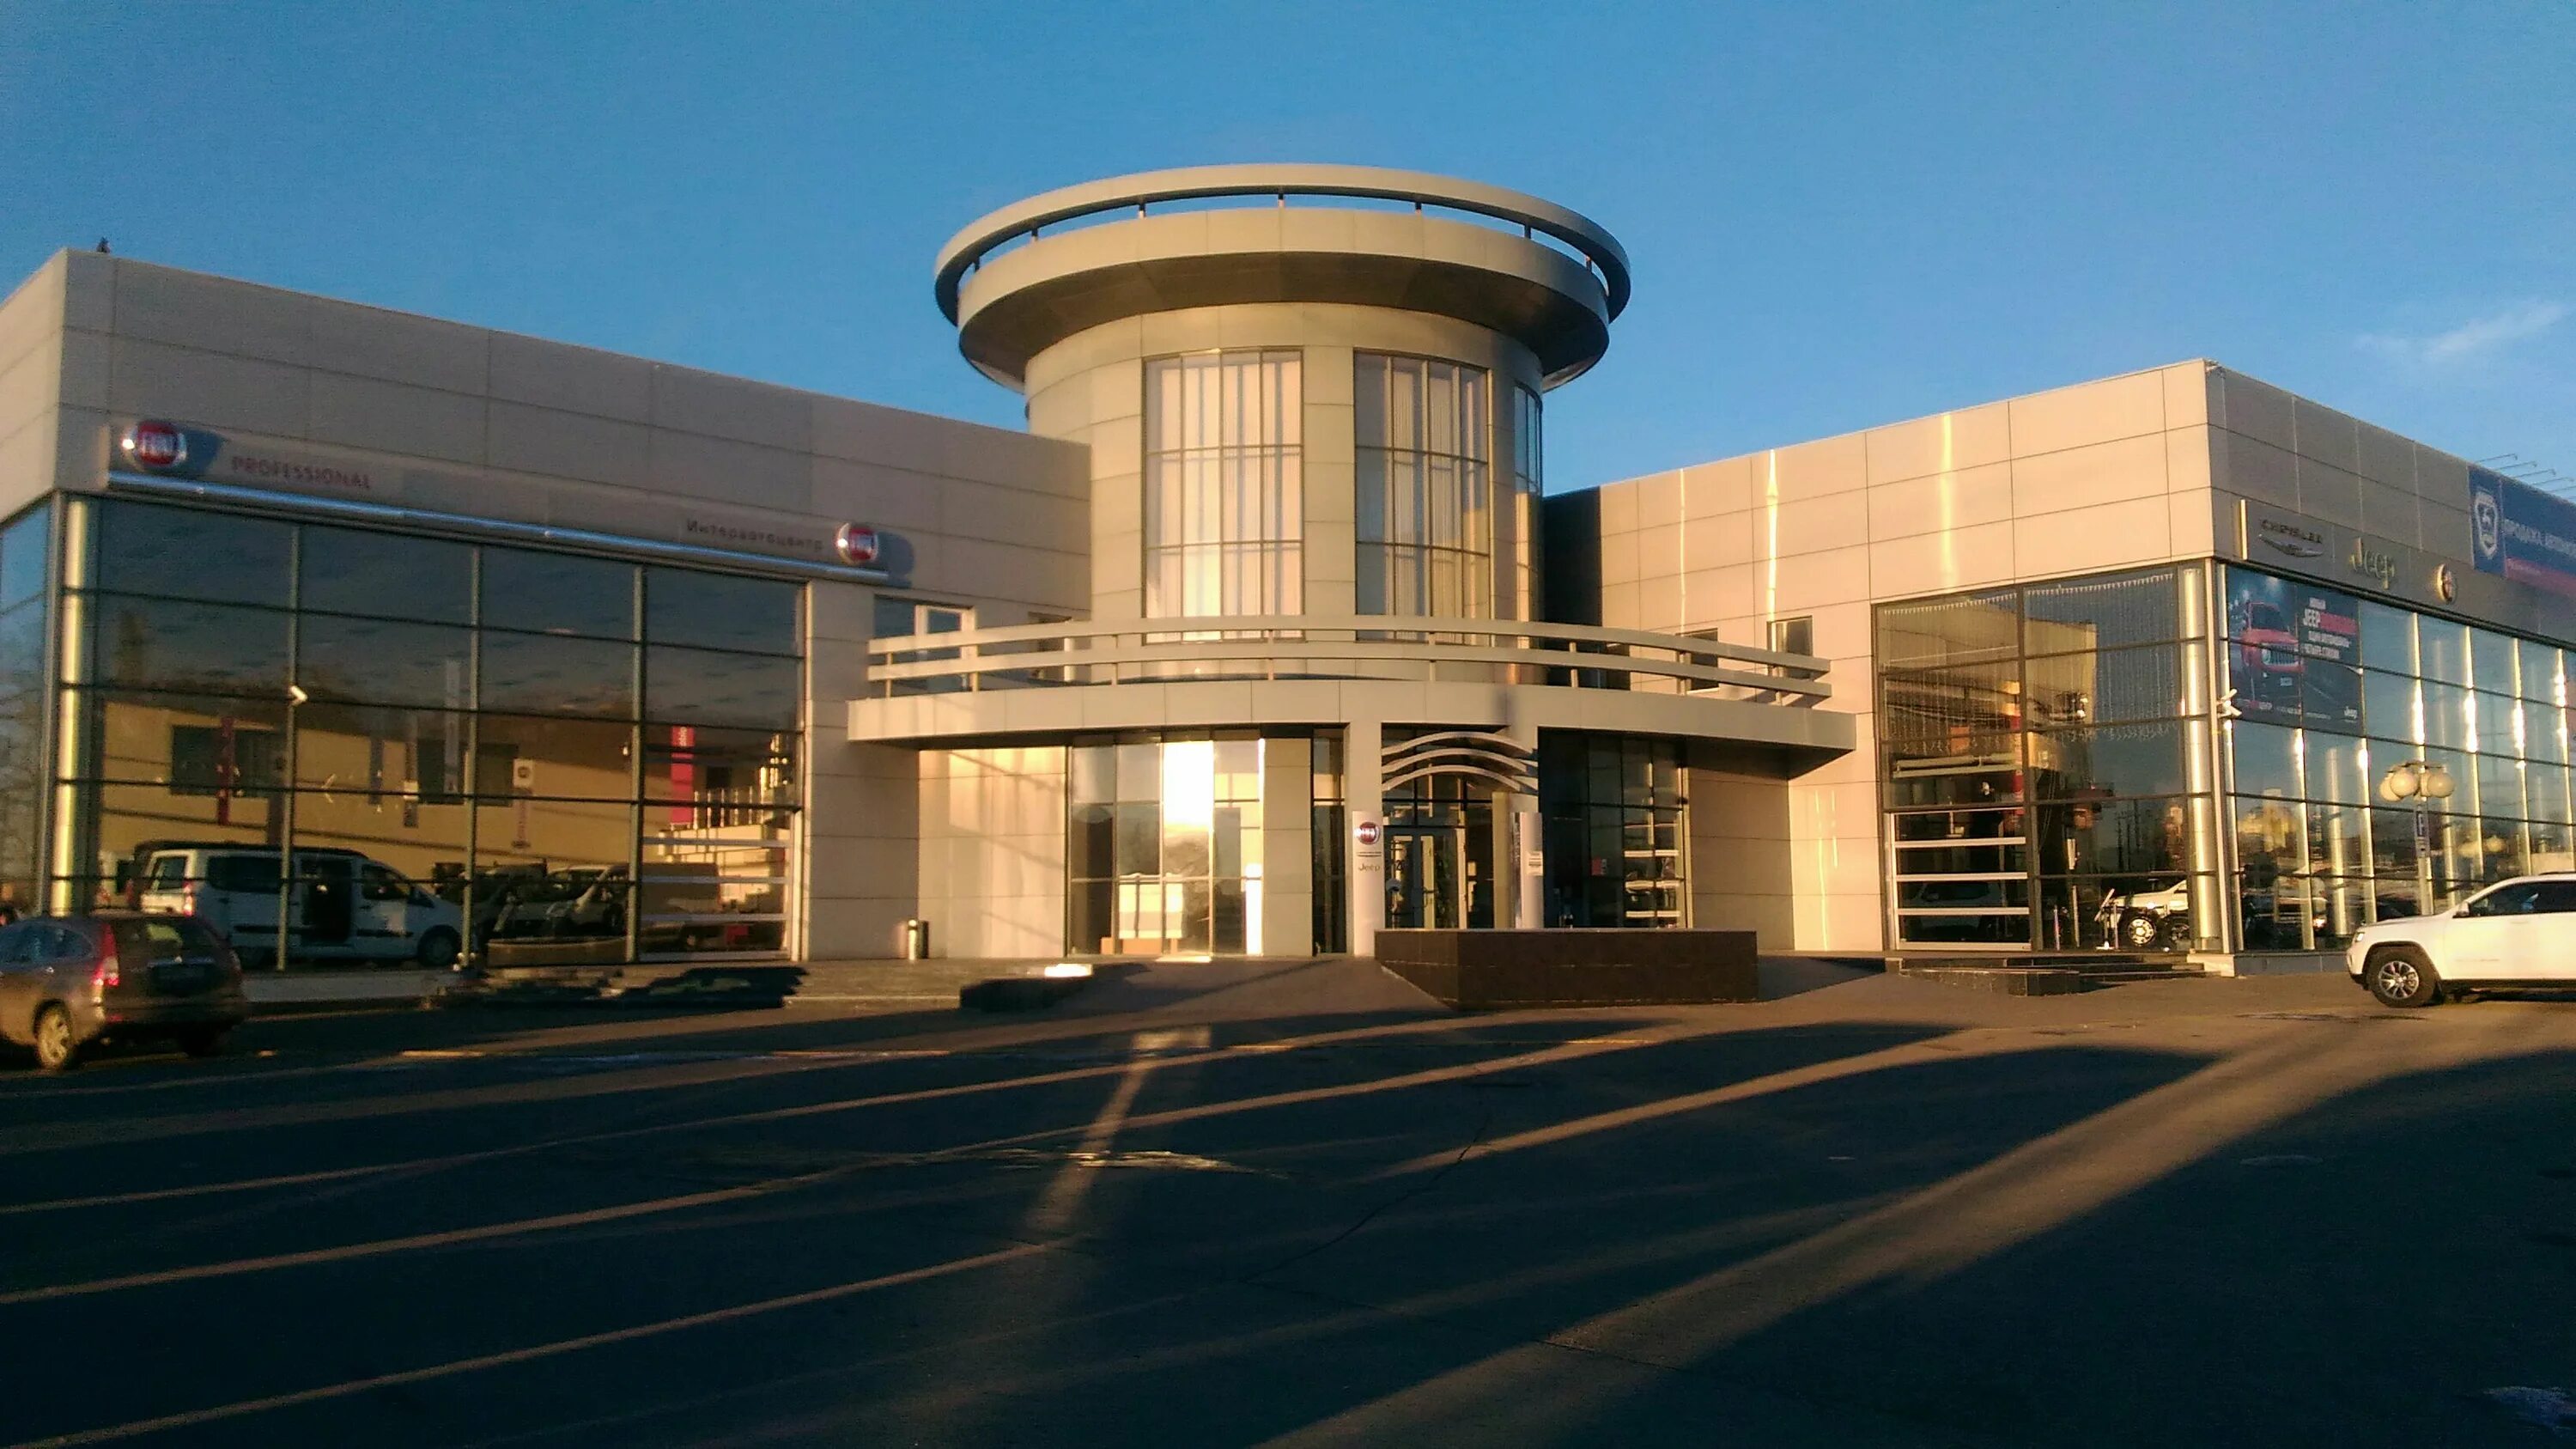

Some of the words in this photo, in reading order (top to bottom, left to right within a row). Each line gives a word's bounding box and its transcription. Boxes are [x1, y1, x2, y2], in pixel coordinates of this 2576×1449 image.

[230, 455, 370, 489] PROFESSIONAL
[2348, 537, 2396, 590] Jeep
[1358, 863, 1381, 872] Jeep
